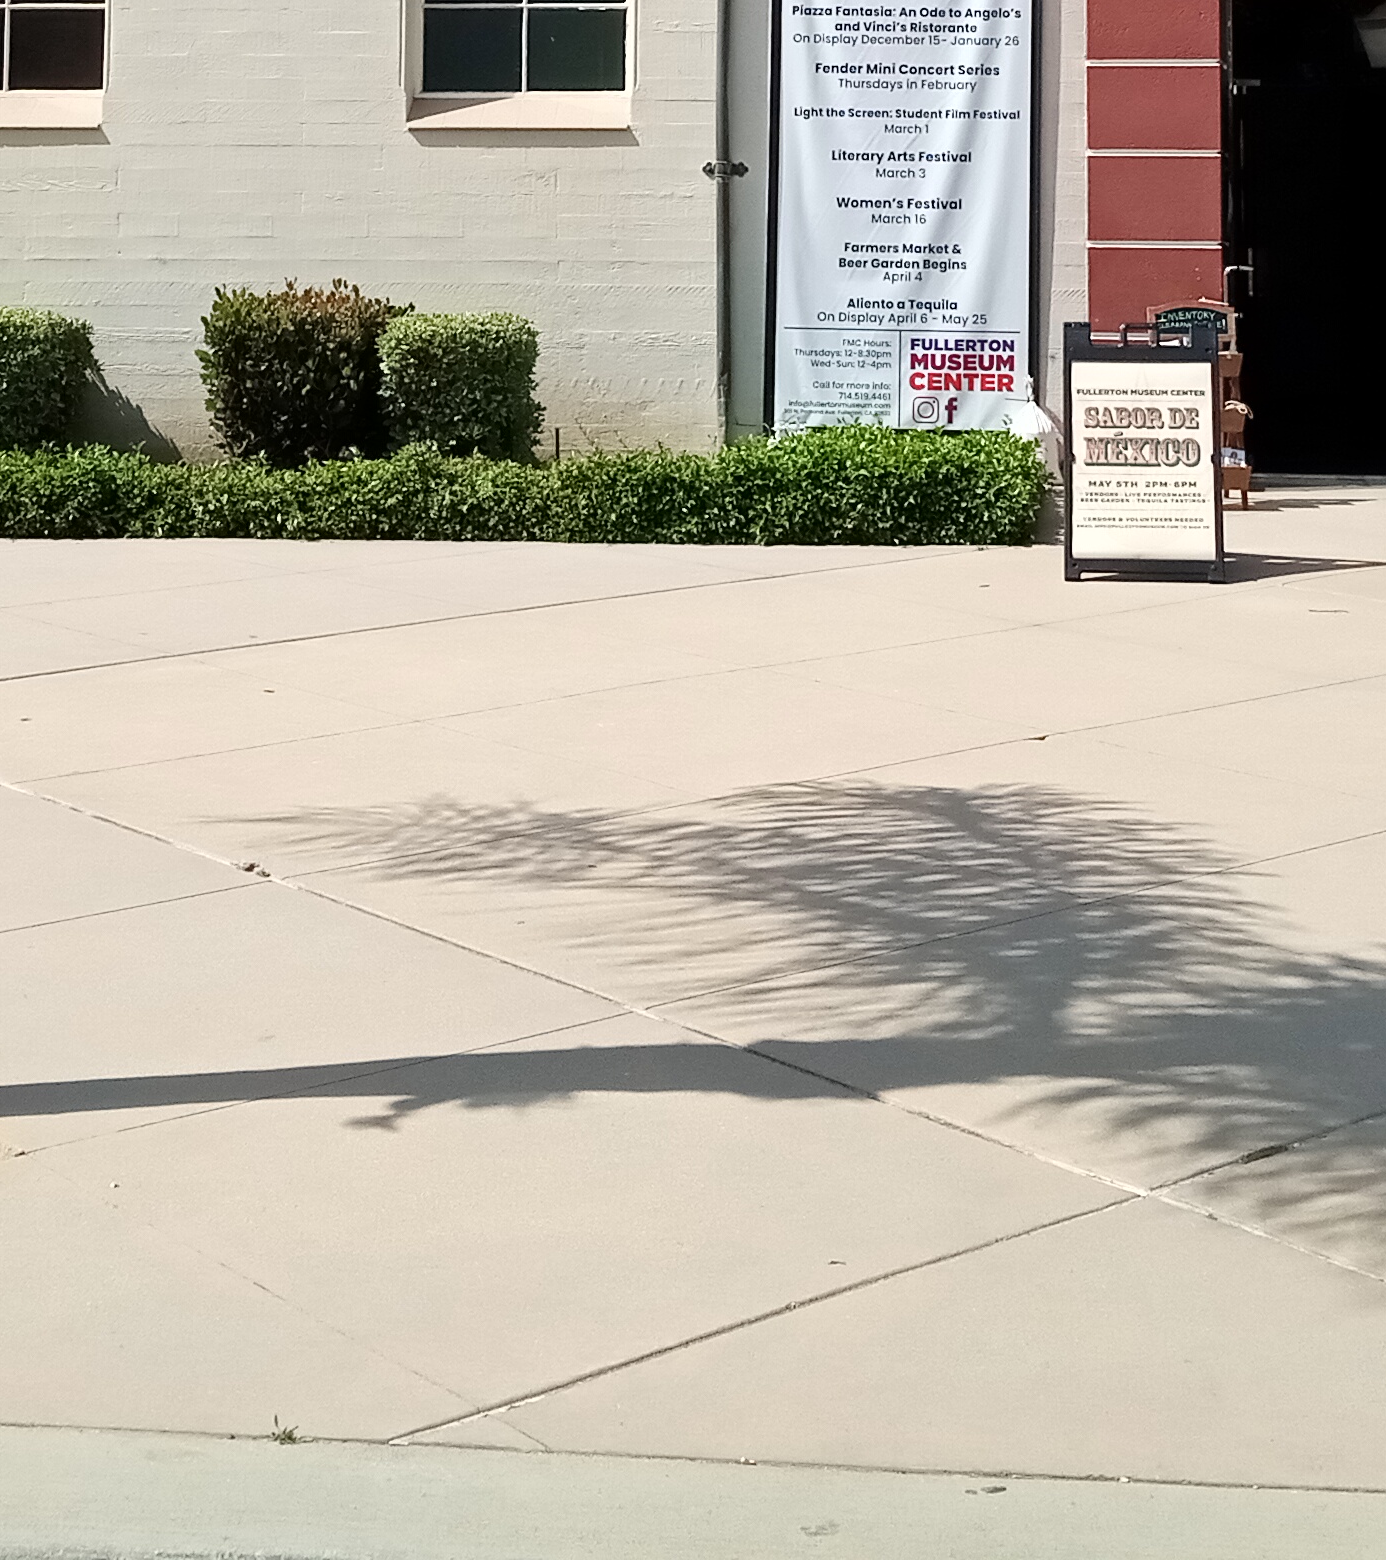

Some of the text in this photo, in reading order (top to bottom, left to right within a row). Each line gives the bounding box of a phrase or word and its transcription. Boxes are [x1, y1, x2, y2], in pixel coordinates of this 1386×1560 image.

[792, 6, 1021, 21] Piazza Fantasia: An Ode to Angelo's
[835, 21, 977, 33] and Vinci's Ristorante
[793, 34, 810, 44] On
[813, 34, 857, 47] Display
[861, 34, 925, 45] December
[951, 36, 1001, 49] January
[1005, 36, 1019, 46] 26
[815, 63, 1000, 76] Fender Mini Concert Series
[838, 79, 977, 93] Thursdays in February
[794, 108, 1020, 120] Light the Screen: Student Film Festival
[884, 124, 929, 134] March 1
[831, 151, 972, 164] Literary Arts Festival
[875, 168, 926, 179] March 3
[836, 197, 962, 210] Women's Festival
[871, 214, 926, 225] March 16
[844, 243, 961, 254] Farmers Market &
[839, 258, 966, 272] Beer Garden Begins
[883, 272, 923, 284] April 4
[847, 298, 958, 313] Aliento a Tequila
[817, 312, 987, 327] On Display April 6 May 25
[1157, 310, 1216, 322] INVENTORY
[842, 339, 861, 347] FMC
[910, 338, 1015, 352] FULLERTON
[794, 348, 843, 358] Thursdays:
[910, 354, 1015, 371] MUSEUM
[812, 381, 830, 389] Call
[832, 381, 844, 389] for
[909, 373, 1014, 392] CENTER
[1084, 406, 1200, 429] SABOR DE
[1083, 431, 1201, 468] MÉXICO
[1088, 480, 1112, 488] MAY
